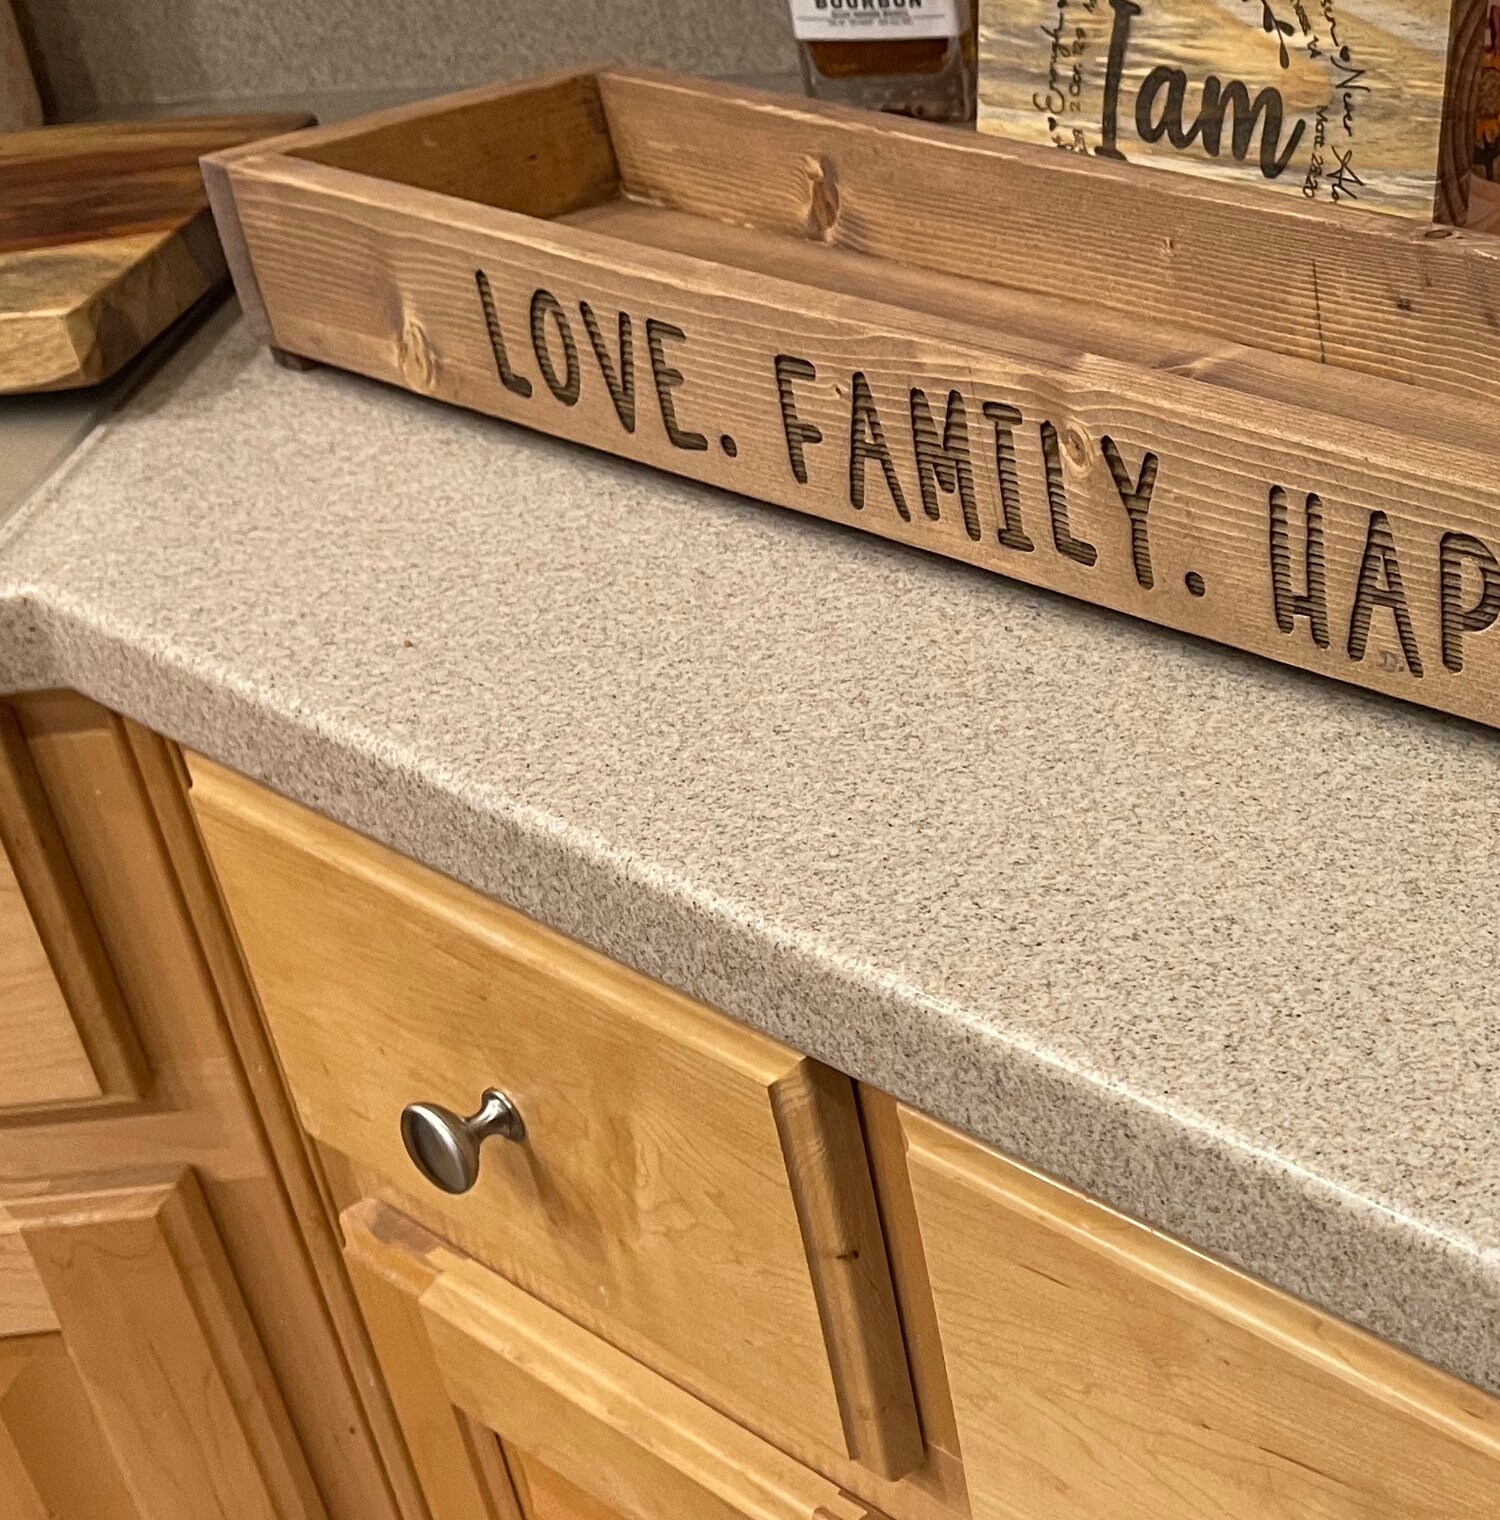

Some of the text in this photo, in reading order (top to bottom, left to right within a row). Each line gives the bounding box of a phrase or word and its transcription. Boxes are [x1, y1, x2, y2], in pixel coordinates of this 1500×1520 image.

[1094, 0, 1306, 179] I am
[1330, 55, 1371, 137] Never
[1326, 145, 1364, 203] Alo
[475, 269, 737, 458] LOVE.
[774, 353, 1206, 598] FAMILY.
